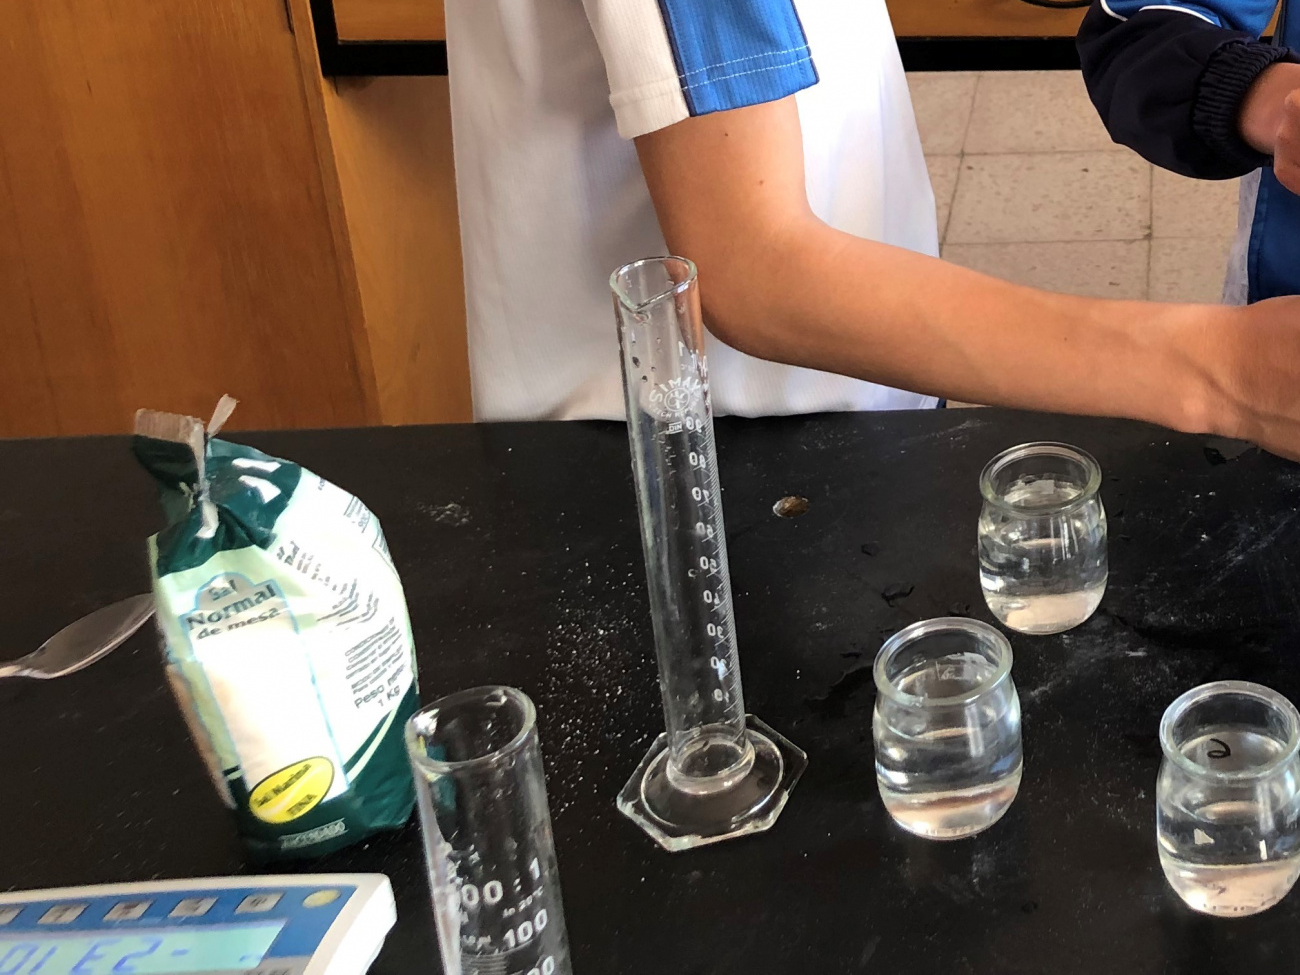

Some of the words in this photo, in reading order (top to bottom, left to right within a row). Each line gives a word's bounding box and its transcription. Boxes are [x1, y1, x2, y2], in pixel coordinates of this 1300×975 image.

[648, 376, 702, 403] SIMAX
[208, 580, 238, 602] Sal
[186, 584, 277, 631] Normal
[197, 627, 222, 640] de
[228, 607, 281, 631] mesa
[354, 684, 385, 709] Peso
[502, 908, 549, 949] 100
